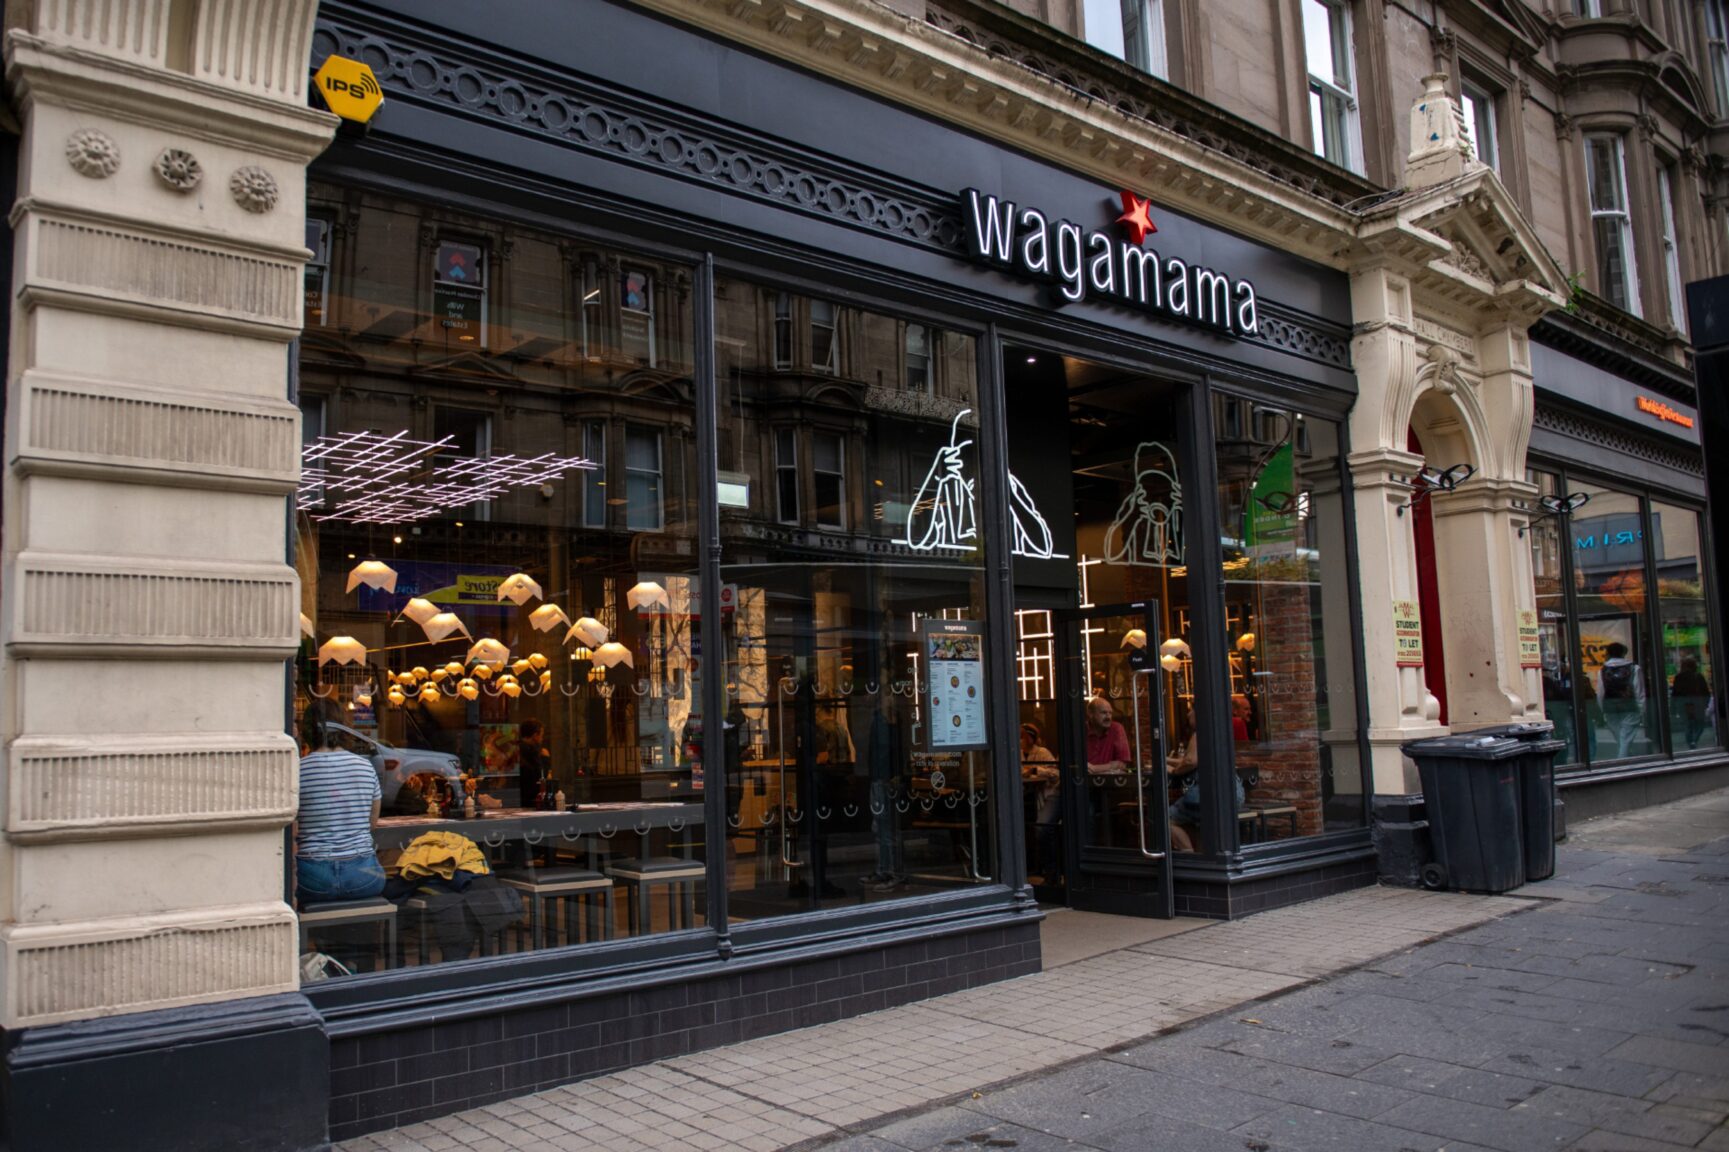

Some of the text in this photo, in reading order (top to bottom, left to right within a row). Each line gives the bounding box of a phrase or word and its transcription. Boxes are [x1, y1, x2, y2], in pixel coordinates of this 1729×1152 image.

[326, 76, 365, 100] IPS
[968, 189, 1260, 334] wagamama
[1396, 620, 1419, 629] STUDENT
